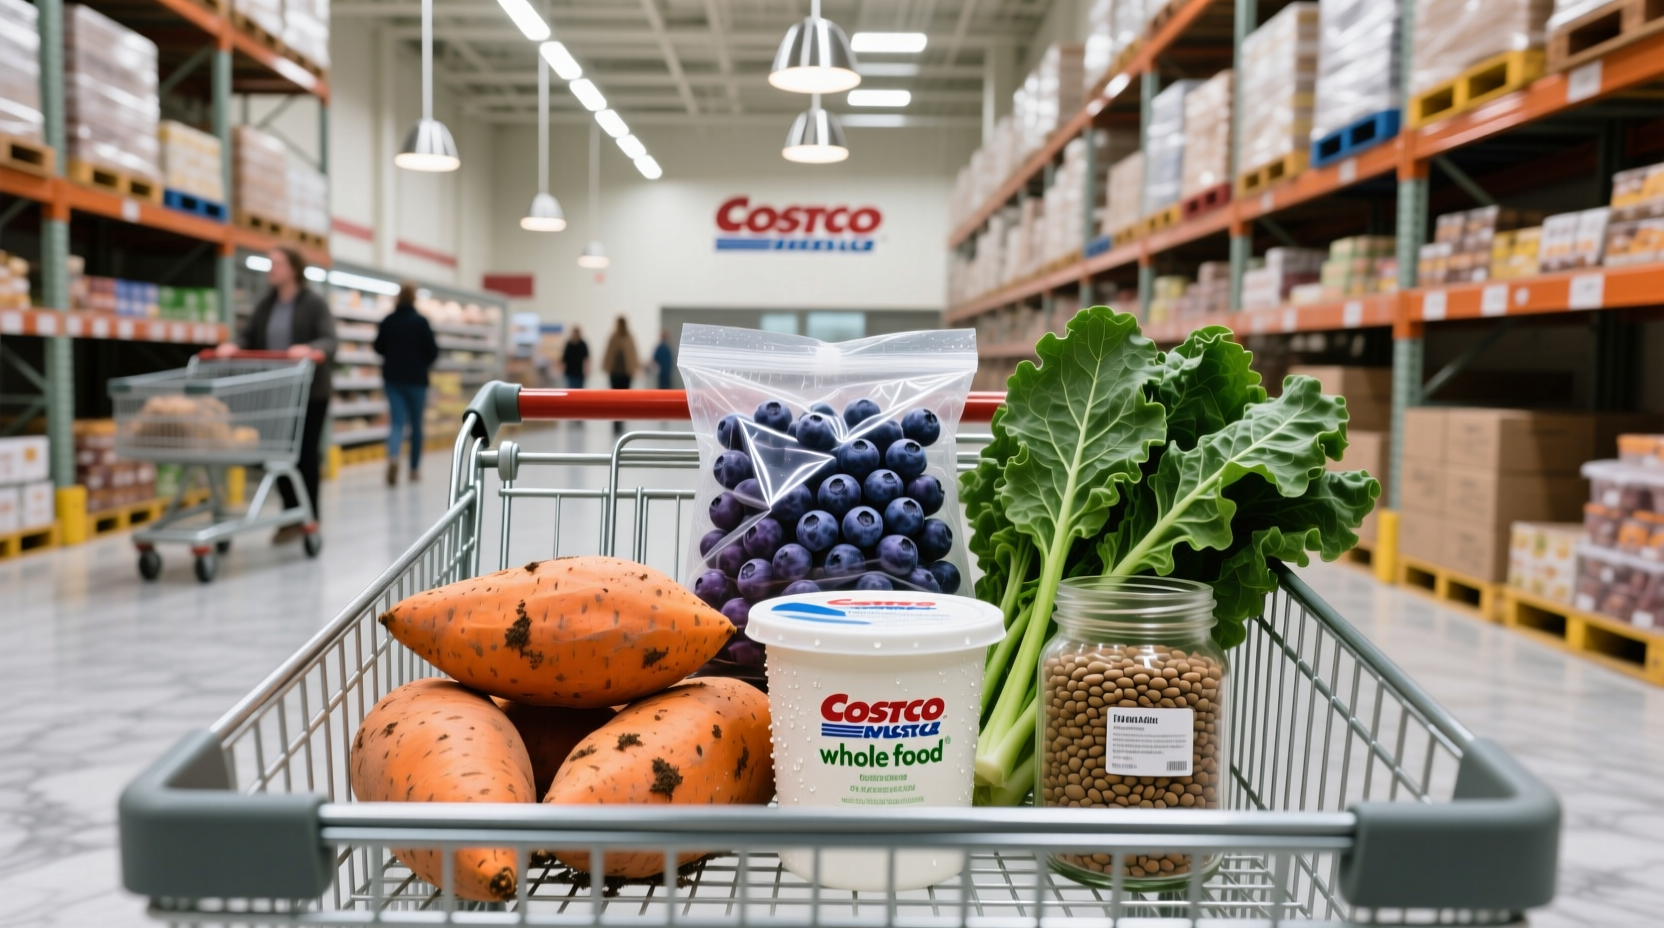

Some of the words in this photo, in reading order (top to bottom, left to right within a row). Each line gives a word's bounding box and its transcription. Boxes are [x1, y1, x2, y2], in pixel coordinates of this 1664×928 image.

[716, 197, 882, 234] COSTCO
[820, 693, 944, 723] COSTCO
[819, 742, 889, 768] whole
[892, 738, 943, 767] food
